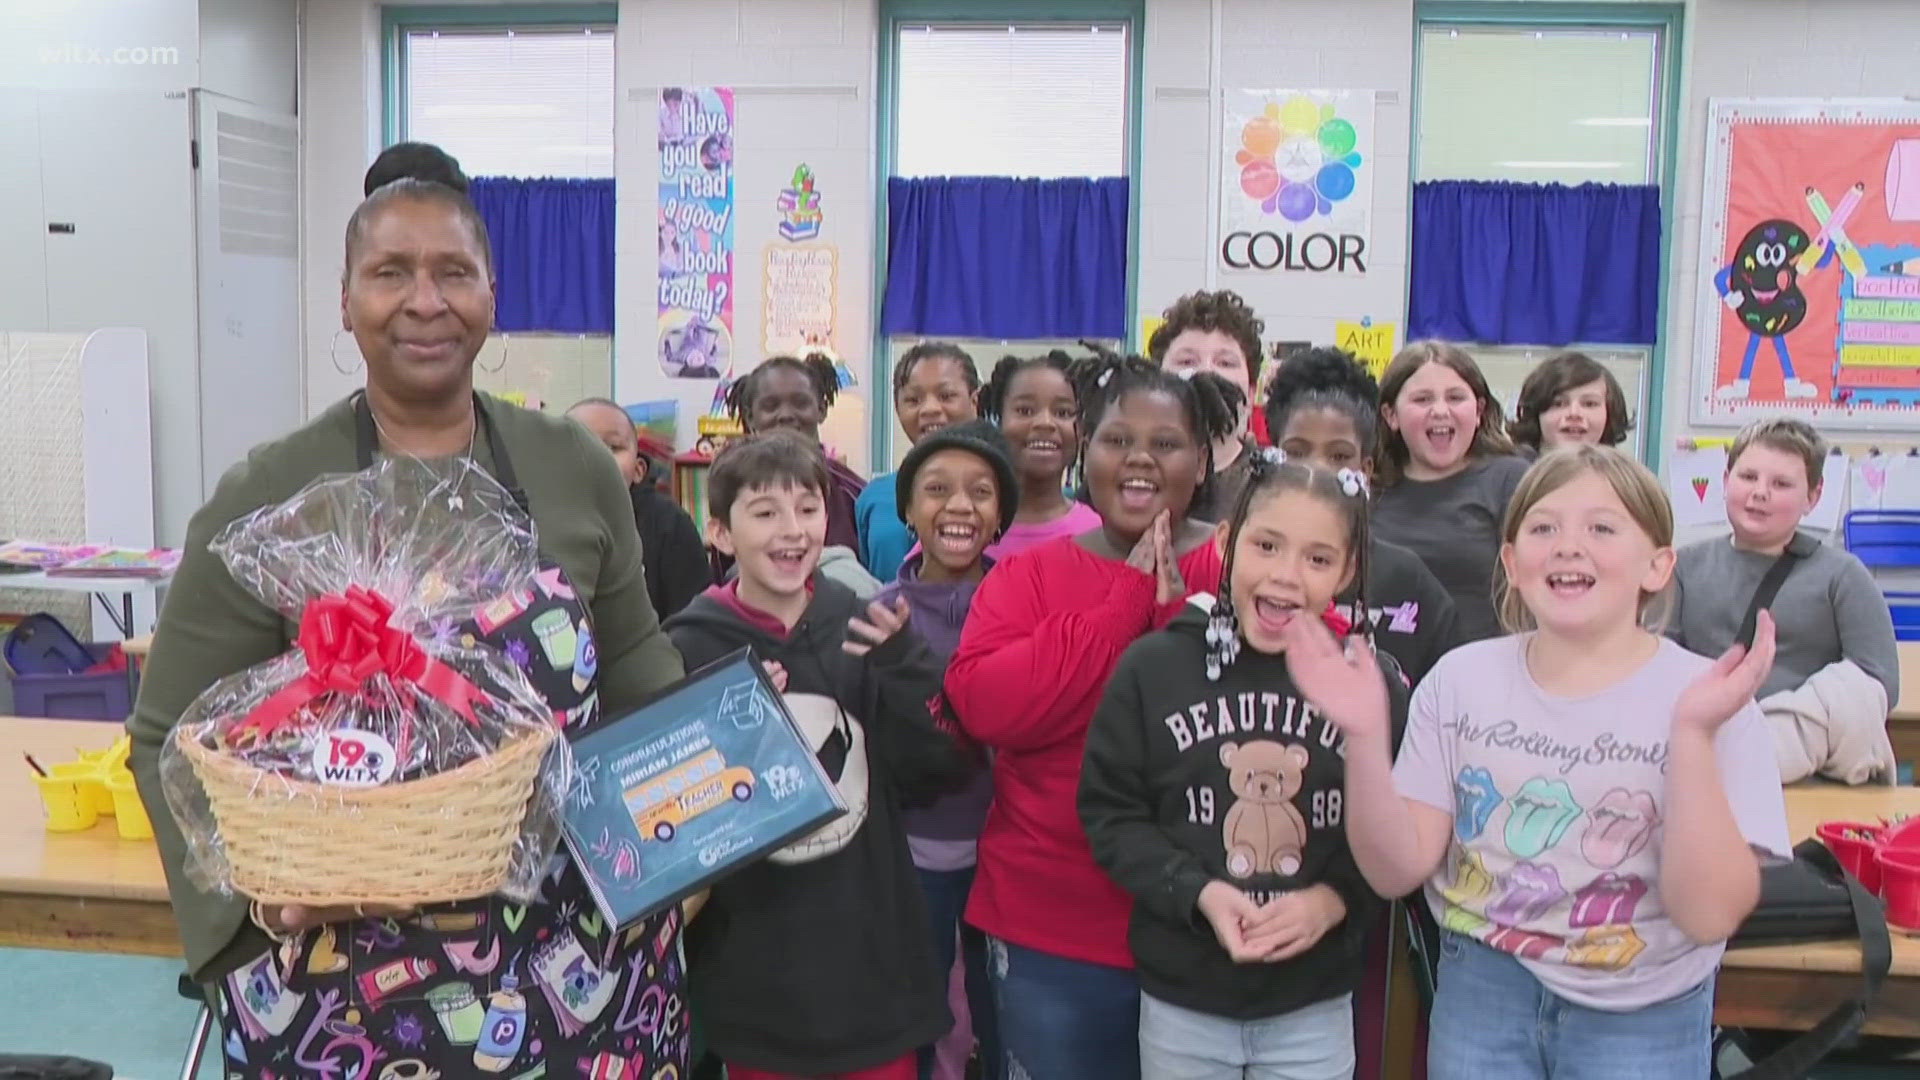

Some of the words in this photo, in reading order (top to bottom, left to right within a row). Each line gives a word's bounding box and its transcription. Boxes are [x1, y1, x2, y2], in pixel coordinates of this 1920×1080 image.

[681, 102, 729, 135] Have
[661, 144, 698, 177] you
[679, 161, 728, 199] read
[664, 199, 676, 219] a
[682, 204, 730, 236] good
[682, 240, 728, 274] book
[1221, 230, 1367, 273] COLOR
[659, 277, 728, 322] today?
[1344, 330, 1385, 349] ART
[329, 735, 366, 767] 19
[610, 718, 706, 774] CONGRATULATIONS
[619, 757, 669, 789] MIRIAM
[669, 734, 711, 765] JAMES
[1474, 719, 1584, 775] Rolling
[324, 766, 380, 783] WLTX
[1185, 785, 1216, 826] 19
[1311, 788, 1343, 829] 98
